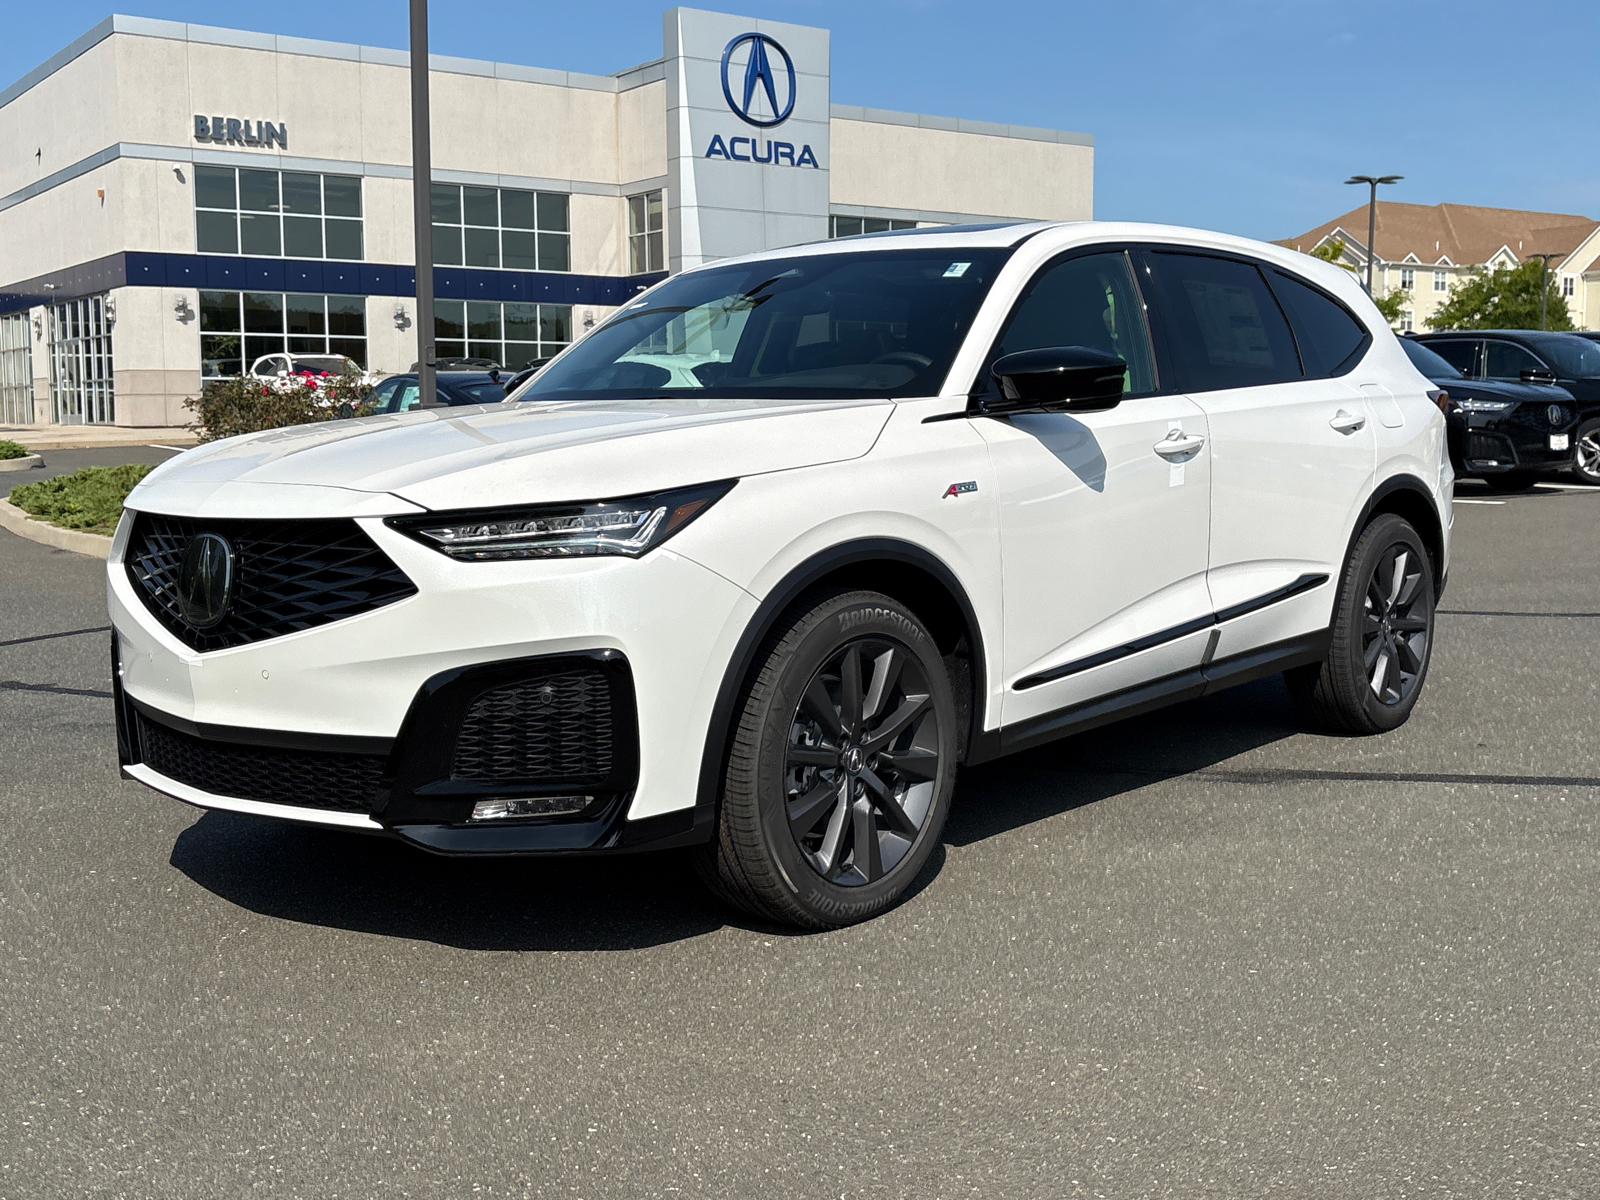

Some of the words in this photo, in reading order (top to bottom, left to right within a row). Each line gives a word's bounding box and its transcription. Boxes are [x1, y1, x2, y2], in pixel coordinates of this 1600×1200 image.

[194, 114, 286, 148] BERLIN
[705, 134, 819, 169] ACURA
[838, 607, 925, 642] BRIDGESTONE
